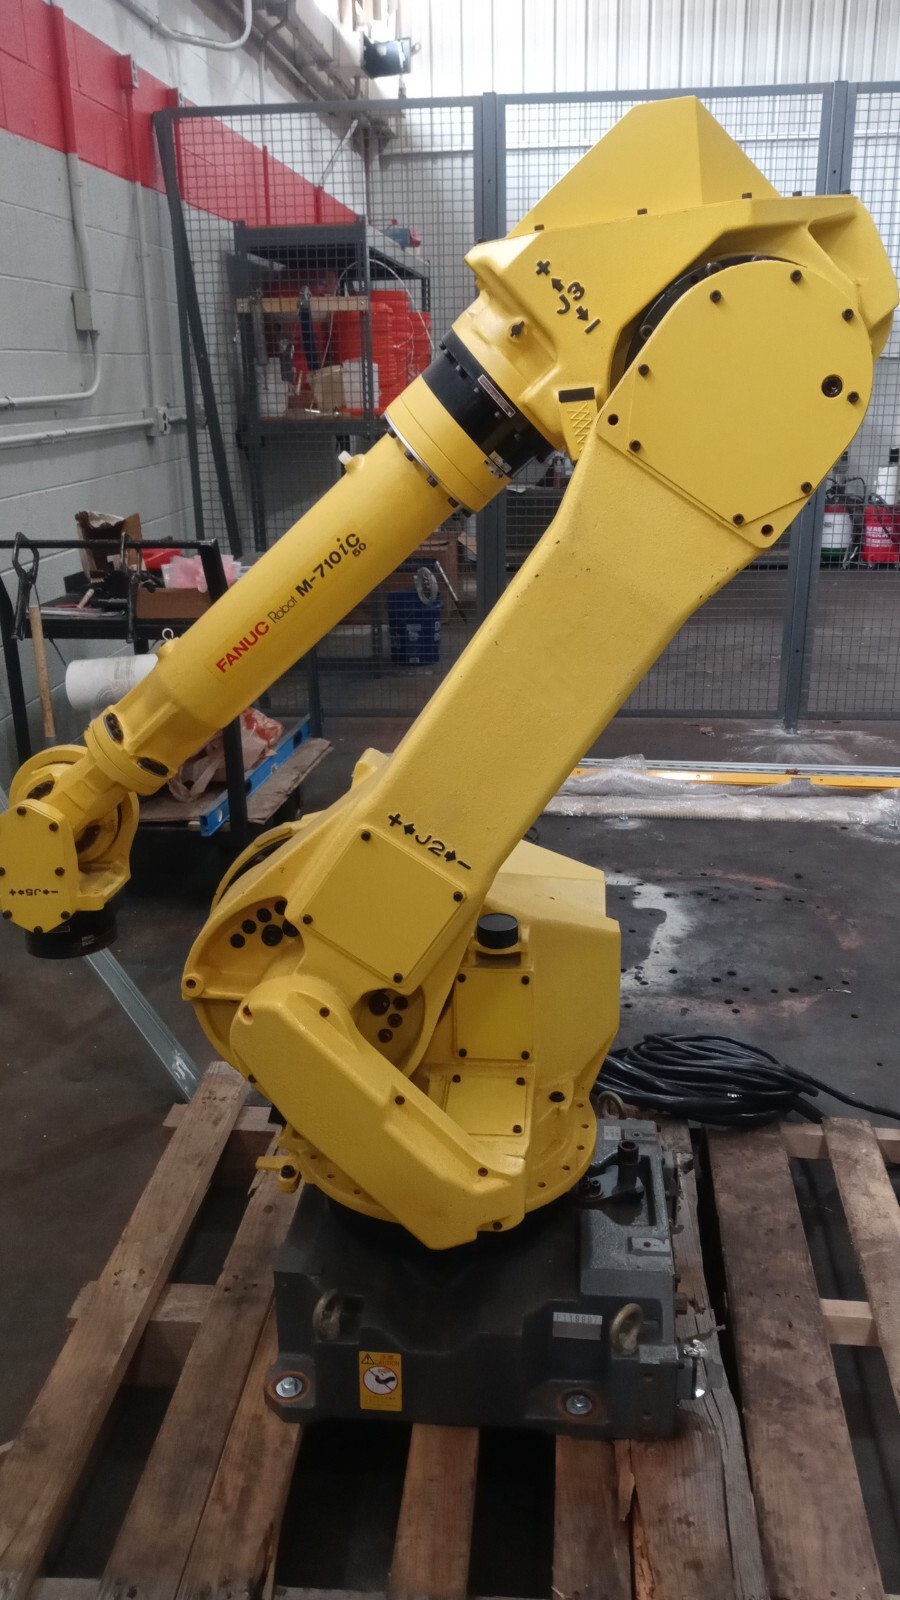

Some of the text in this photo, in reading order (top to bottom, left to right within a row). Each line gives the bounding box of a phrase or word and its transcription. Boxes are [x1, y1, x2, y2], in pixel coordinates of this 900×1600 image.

[557, 281, 585, 315] J3
[216, 533, 360, 673] FANUC Robot M-710iC
[415, 835, 446, 857] J2
